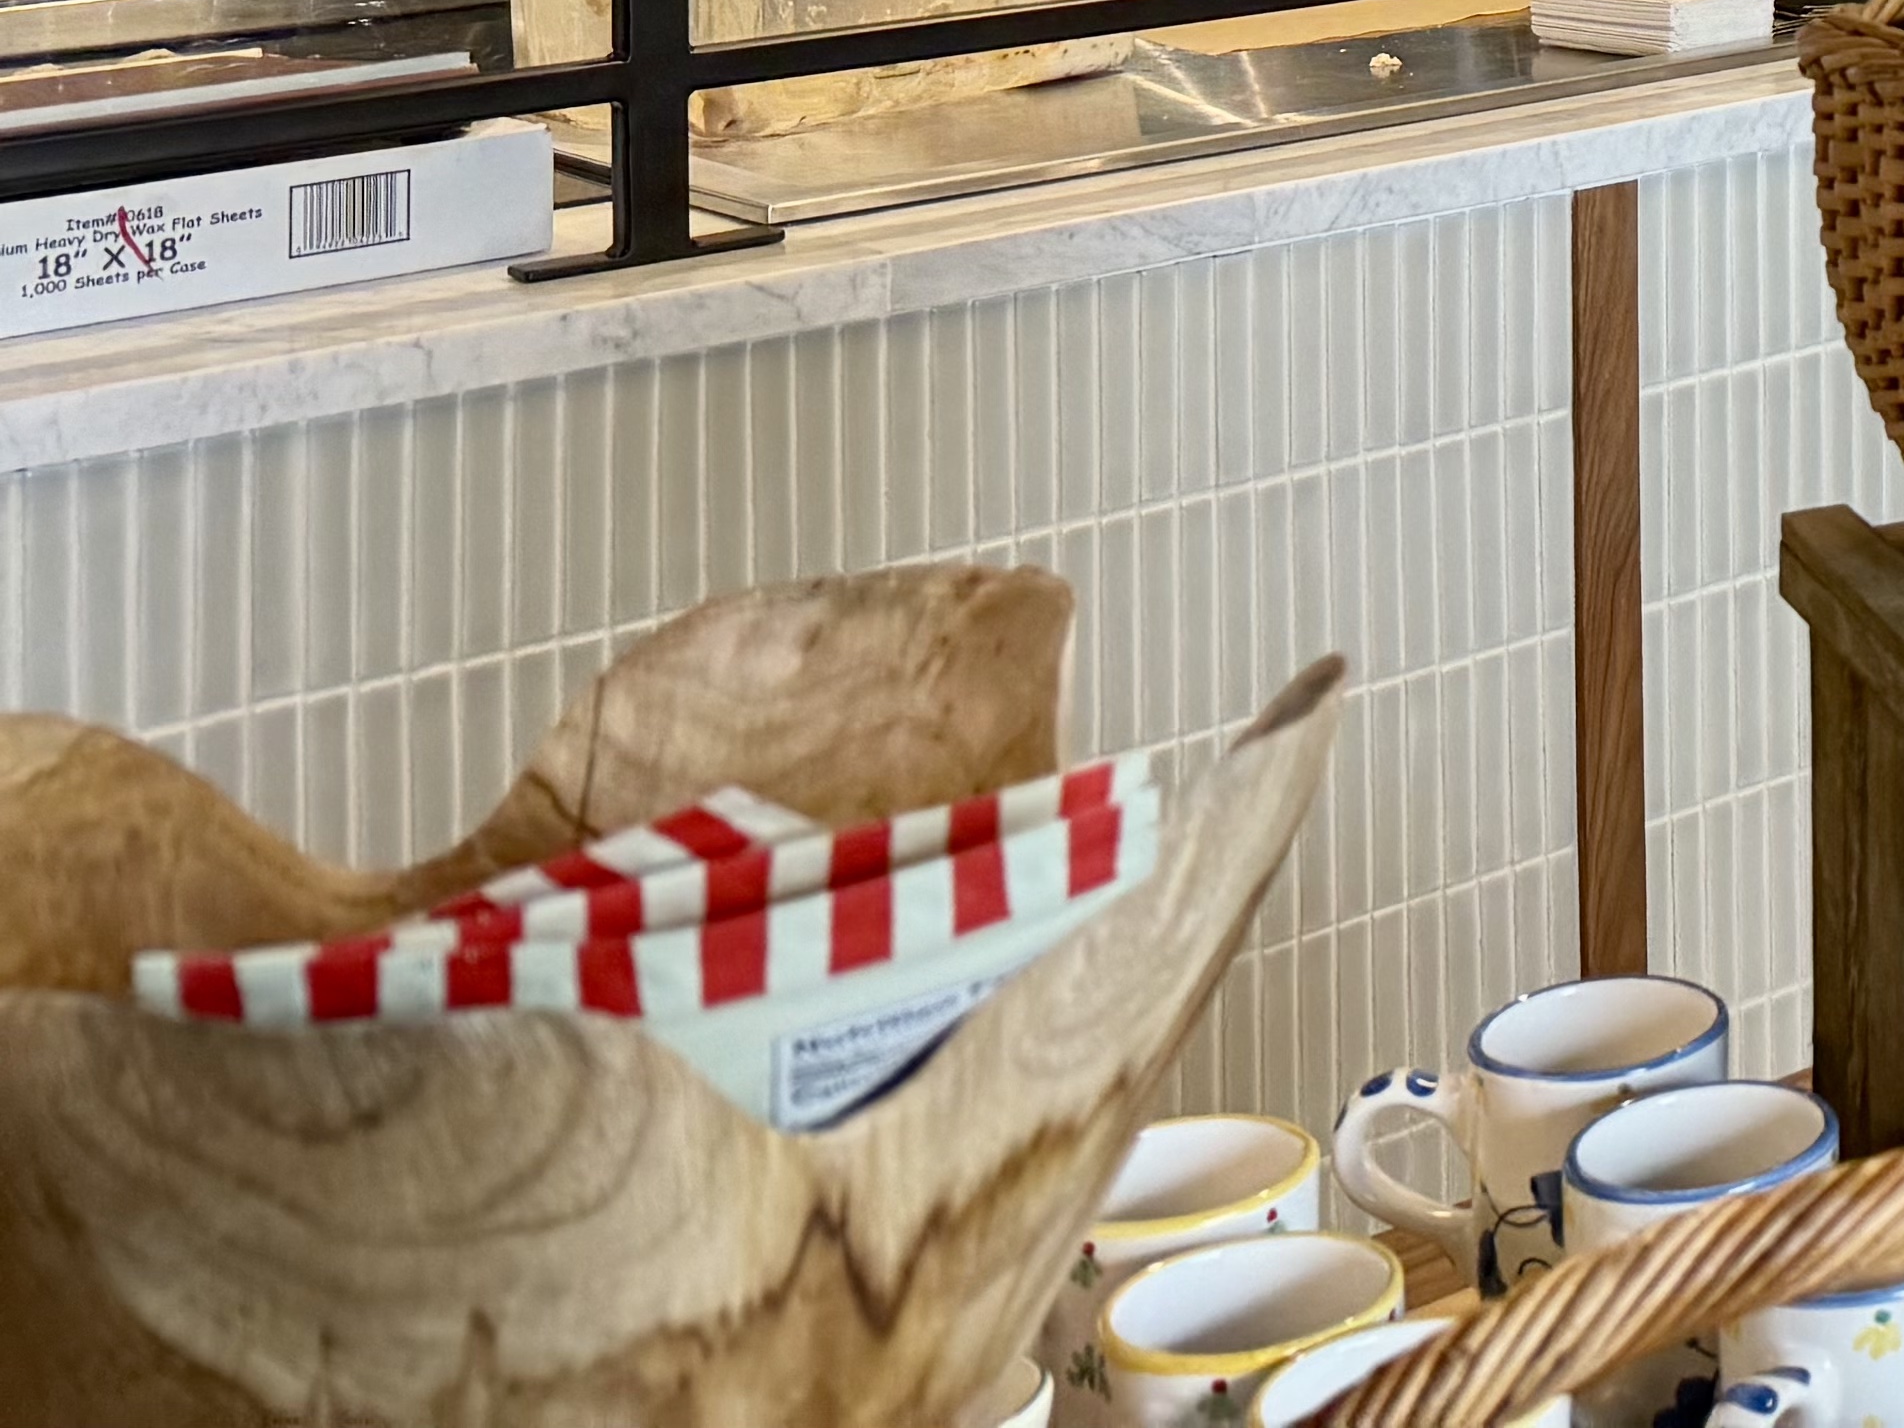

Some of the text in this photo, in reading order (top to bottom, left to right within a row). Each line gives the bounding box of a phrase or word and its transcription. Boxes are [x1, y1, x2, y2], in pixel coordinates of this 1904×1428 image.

[35, 234, 86, 252] Heavy
[172, 216, 202, 232] Flat
[209, 207, 263, 227] Sheets
[66, 206, 164, 232] Item#0618
[38, 232, 192, 280] 18" X 18"
[20, 259, 207, 299] 1,000 Sheets per Case
